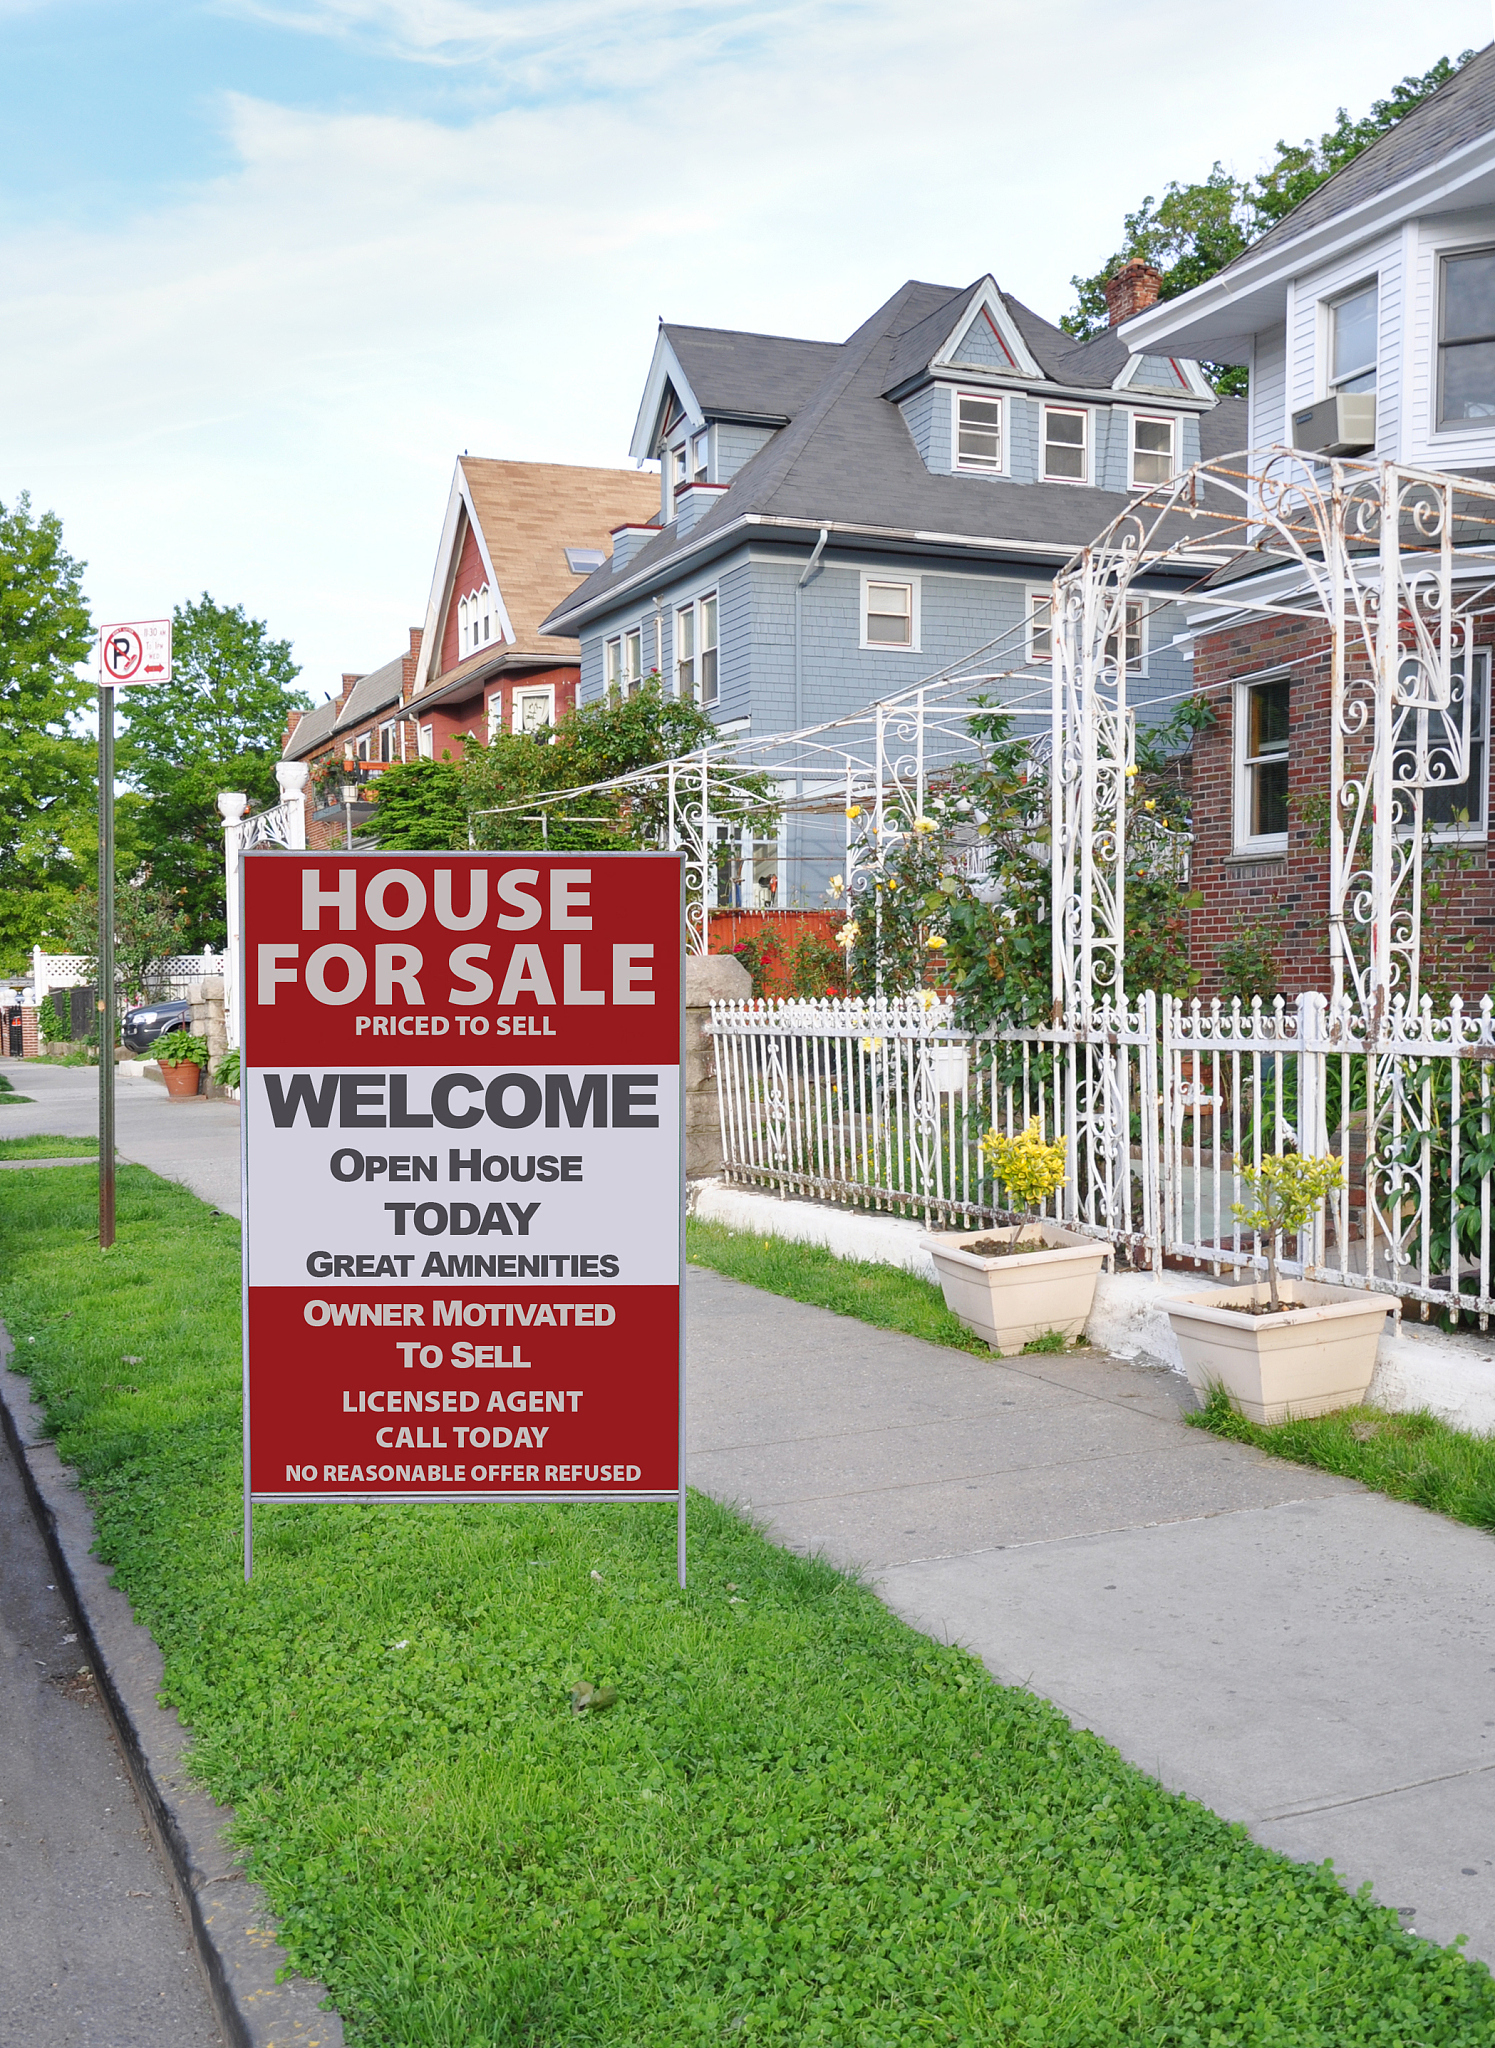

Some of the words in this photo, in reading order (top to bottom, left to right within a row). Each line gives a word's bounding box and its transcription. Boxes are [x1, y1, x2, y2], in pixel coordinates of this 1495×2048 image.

[302, 869, 592, 931] HOUSE
[258, 943, 425, 1005] FOR
[449, 944, 655, 1005] SALE
[356, 1016, 449, 1035] PRICED
[455, 1016, 489, 1035] TO
[497, 1016, 556, 1035] SELL
[263, 1073, 659, 1129] WELCOME
[330, 1148, 437, 1182] OPEN
[449, 1149, 582, 1182] HOUSE
[384, 1202, 541, 1236] TODAY
[307, 1251, 415, 1277] GREAT
[421, 1252, 619, 1277] AMNENITIES
[304, 1300, 425, 1326] OWNER
[433, 1301, 615, 1326] MOTIVATED
[396, 1342, 443, 1368] TO
[451, 1342, 531, 1368] SELL
[343, 1391, 479, 1412] LICENSED
[487, 1391, 583, 1412] AGENT
[376, 1427, 447, 1448] CALL
[453, 1427, 549, 1448] TODAY
[286, 1465, 317, 1481] NO
[324, 1465, 465, 1481] REASONABLE
[471, 1465, 539, 1481] OFFER
[545, 1465, 641, 1481] REFUSED
